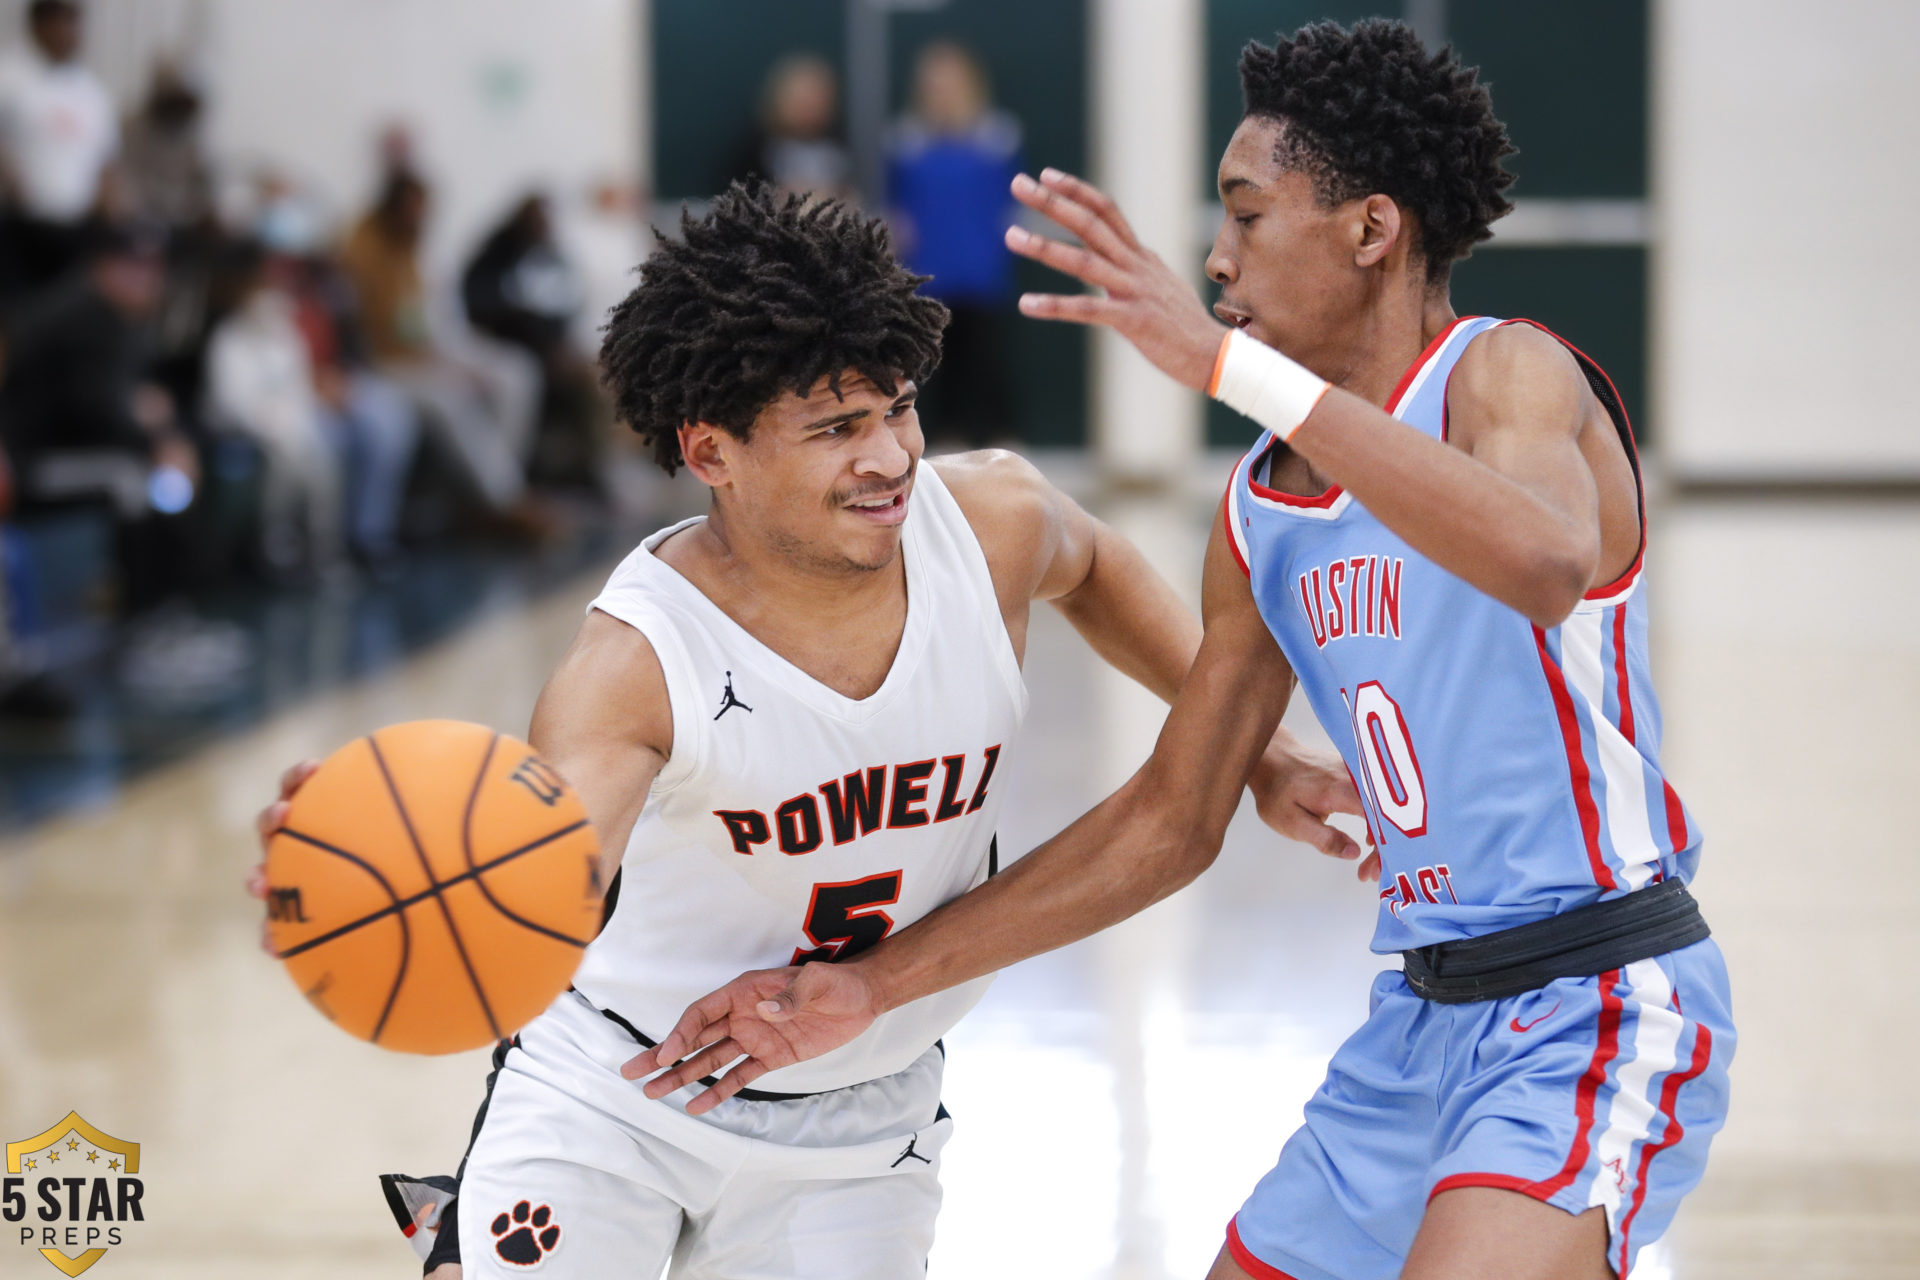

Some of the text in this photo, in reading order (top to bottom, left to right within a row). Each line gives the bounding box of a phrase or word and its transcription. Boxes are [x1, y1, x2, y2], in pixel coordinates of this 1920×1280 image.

[1290, 554, 1404, 650] USTIN
[712, 743, 1002, 856] POWELL
[789, 868, 903, 966] 5
